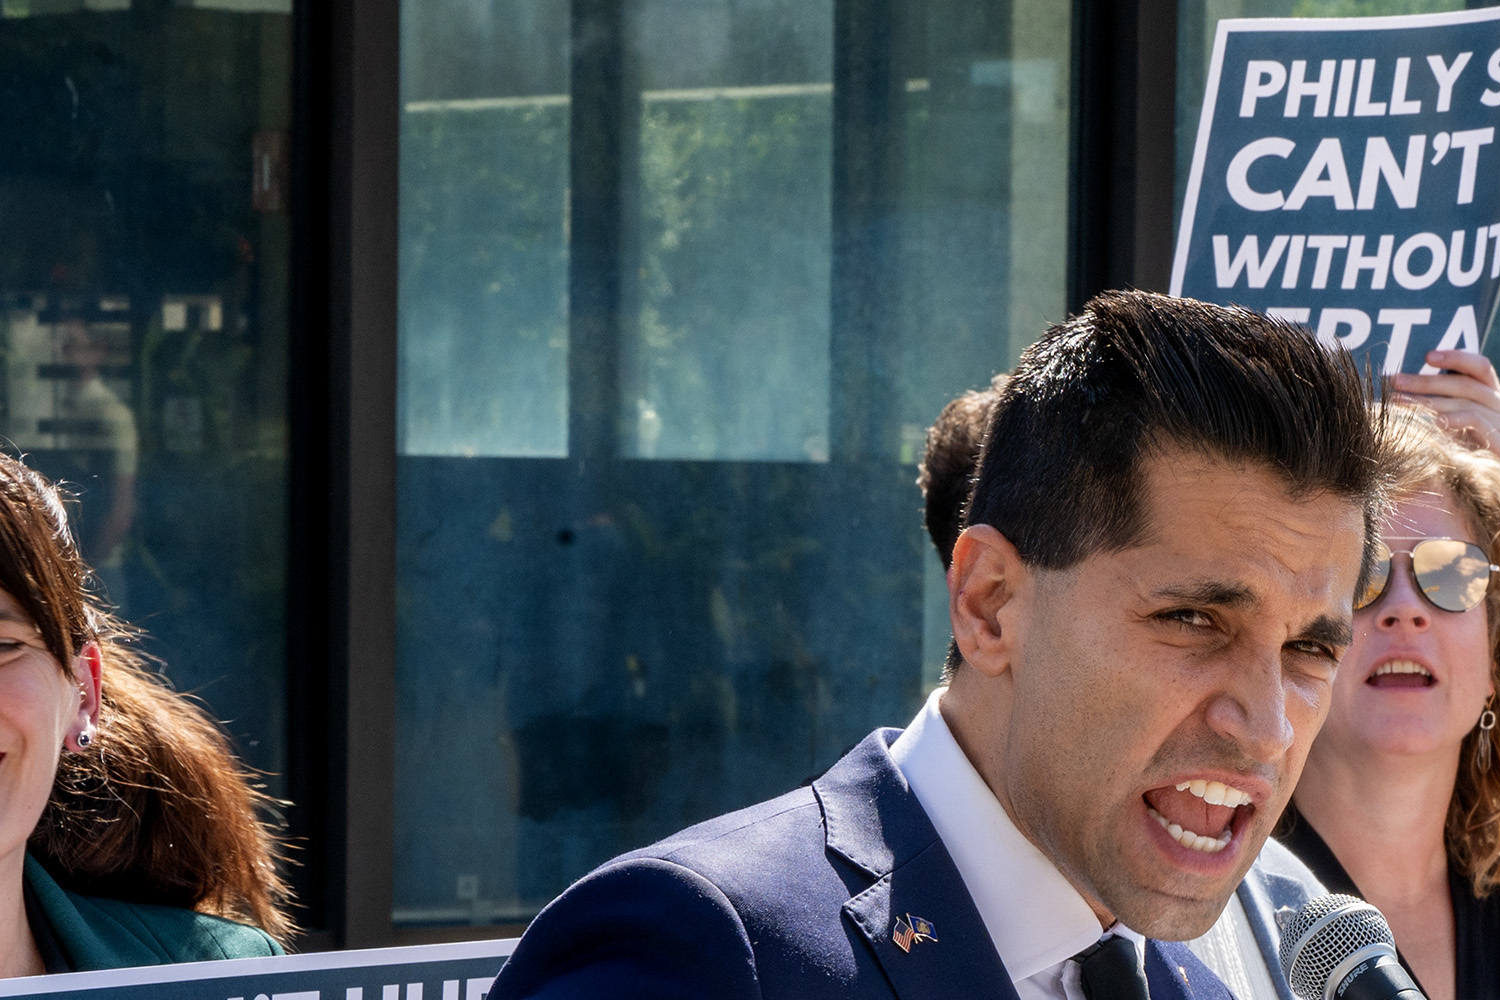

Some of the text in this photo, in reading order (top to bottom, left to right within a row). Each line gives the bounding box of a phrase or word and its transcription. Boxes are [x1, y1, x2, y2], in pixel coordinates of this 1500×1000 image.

[1239, 52, 1474, 118] PHILLY
[1226, 127, 1495, 212] CAN'T
[1337, 962, 1369, 997] SHURE
